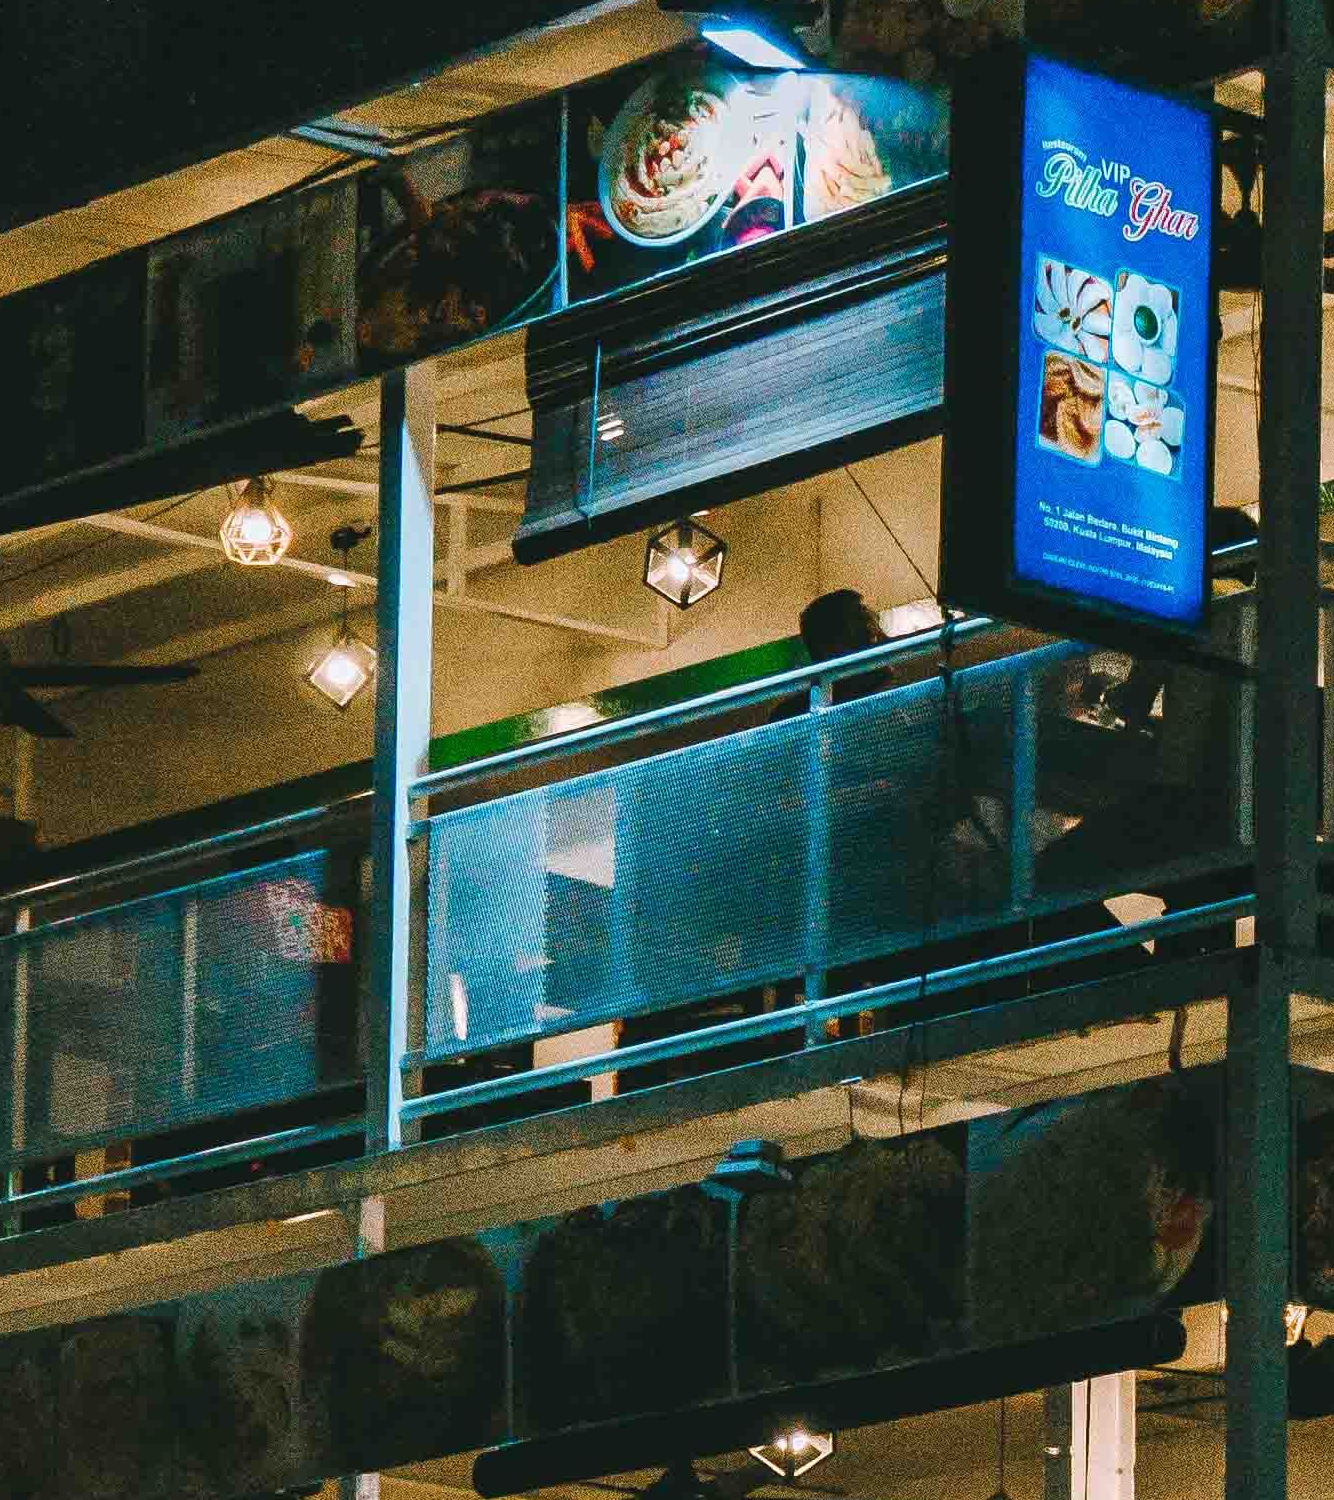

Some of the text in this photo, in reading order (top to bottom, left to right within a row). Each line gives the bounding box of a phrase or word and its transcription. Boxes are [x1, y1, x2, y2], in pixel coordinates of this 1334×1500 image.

[1101, 158, 1131, 185] VIP
[1123, 177, 1199, 242] Ghar
[1073, 524, 1097, 540] Kuala
[1136, 541, 1173, 560] Malaysia
[1121, 523, 1144, 538] Bukit
